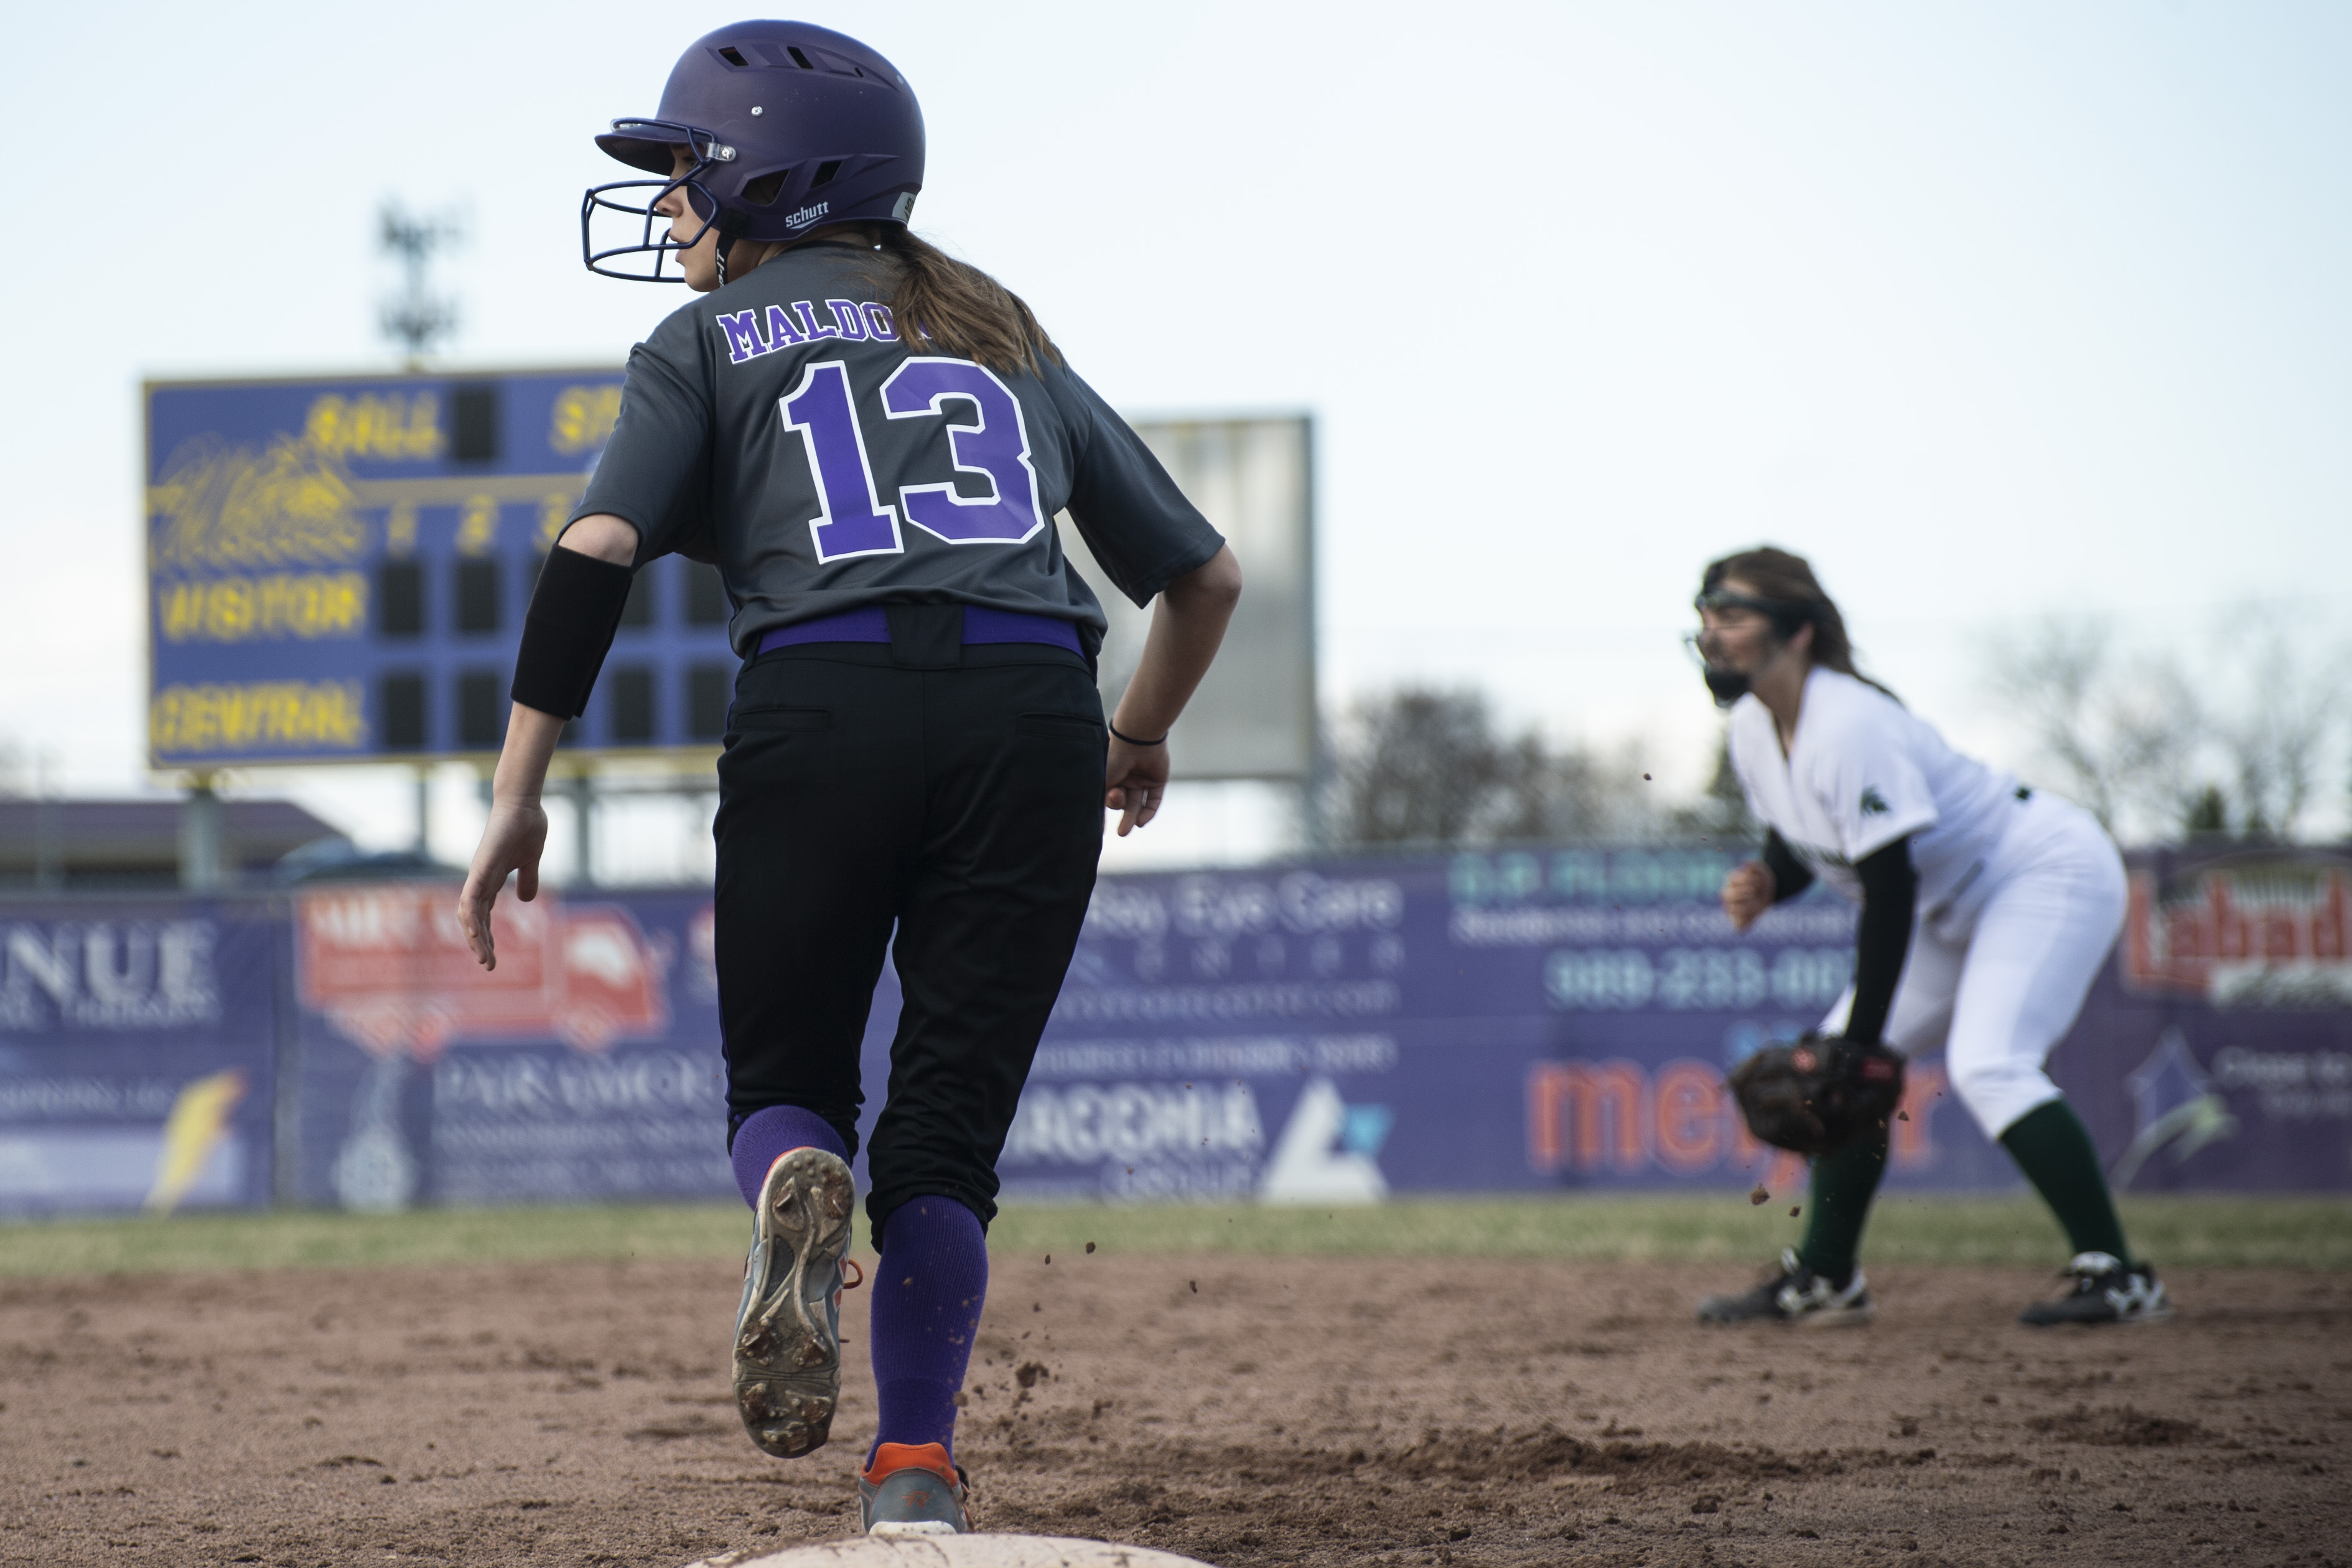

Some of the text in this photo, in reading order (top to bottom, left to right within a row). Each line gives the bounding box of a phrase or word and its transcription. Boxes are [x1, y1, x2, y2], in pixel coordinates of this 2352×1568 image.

[785, 201, 829, 228] schutt
[716, 248, 725, 287] P-IT
[716, 298, 933, 364] MALDO
[308, 394, 444, 458] BALL
[779, 357, 1045, 564] 13
[164, 577, 365, 639] VISITOR
[154, 684, 364, 748] CENTRAL
[1282, 875, 1401, 929] Care
[7, 924, 215, 997] NUE
